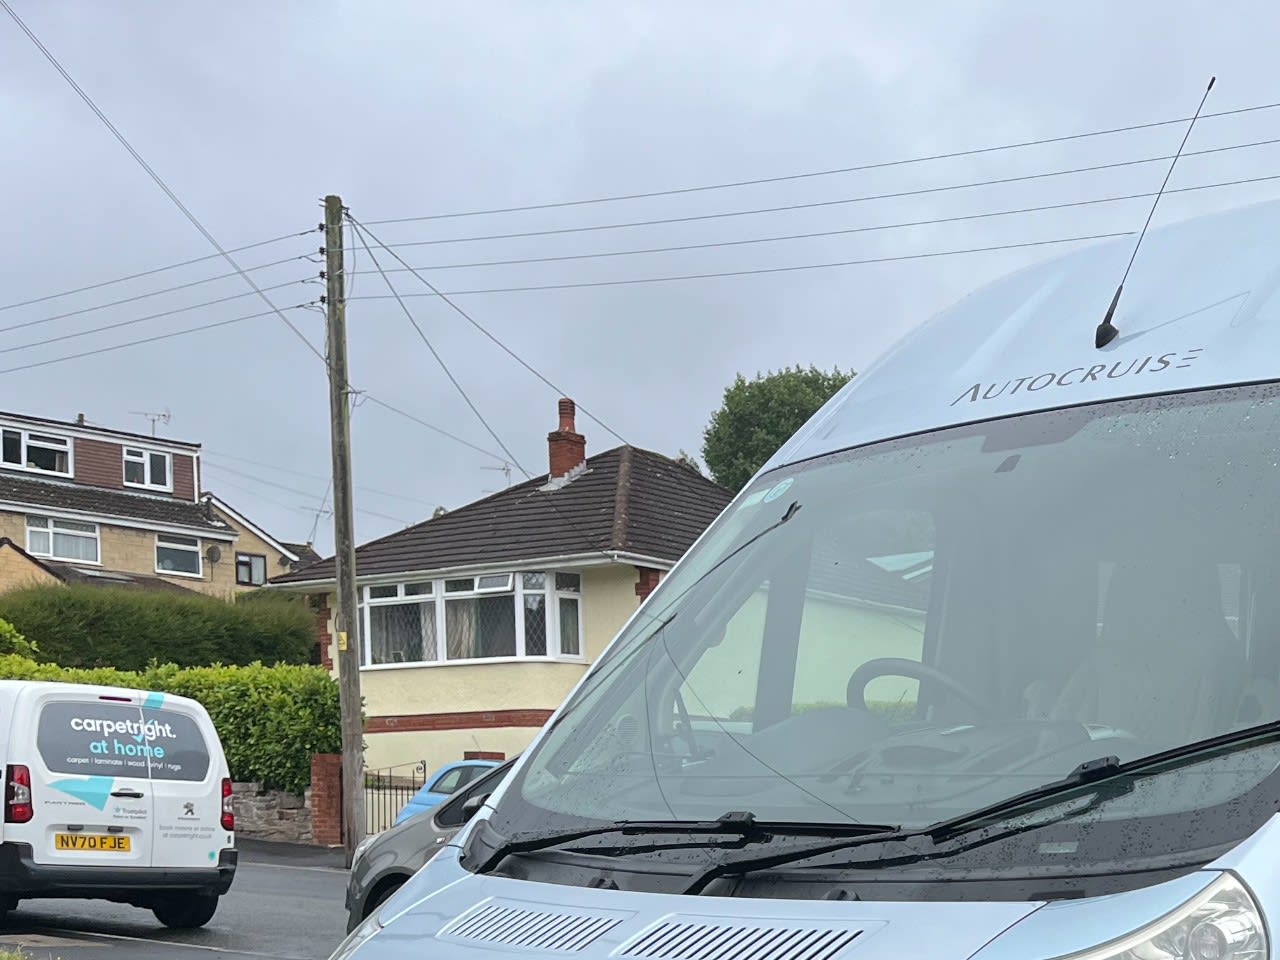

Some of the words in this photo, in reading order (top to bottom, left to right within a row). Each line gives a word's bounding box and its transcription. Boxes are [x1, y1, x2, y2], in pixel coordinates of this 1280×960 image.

[950, 348, 1203, 406] AUTOCRUISE
[89, 740, 109, 754] at
[113, 739, 165, 758] home
[66, 757, 90, 765] carpet
[60, 835, 97, 848] NV70
